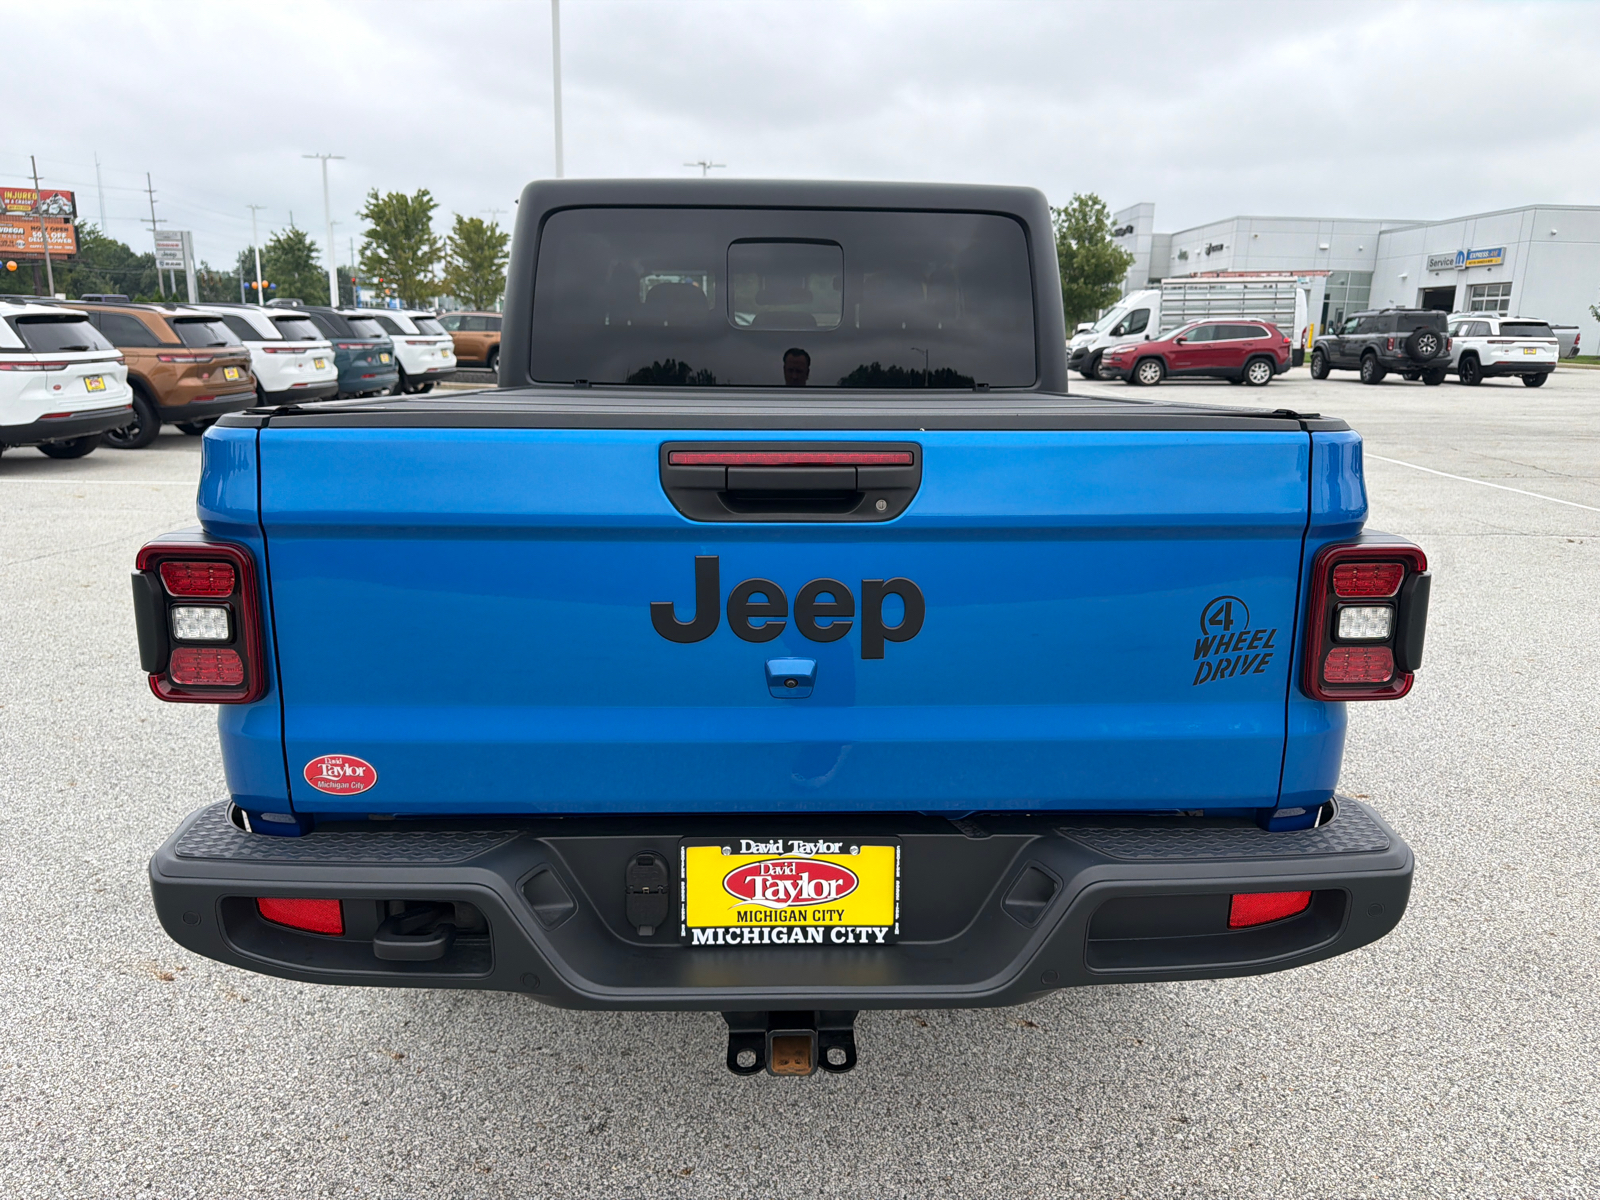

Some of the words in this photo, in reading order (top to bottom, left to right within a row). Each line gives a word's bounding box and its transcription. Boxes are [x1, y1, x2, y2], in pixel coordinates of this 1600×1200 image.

[4, 191, 37, 200] INJURED
[1429, 257, 1454, 267] Service
[650, 555, 926, 660] Jeep
[1208, 601, 1234, 631] 4
[1193, 628, 1278, 661] WHEEL
[1192, 652, 1275, 686] DRIVE
[324, 757, 343, 765] David
[317, 763, 366, 780] Taylor
[317, 780, 350, 790] Michigan
[350, 781, 365, 790] City
[740, 839, 784, 854] David
[788, 839, 843, 859] Taylor
[759, 863, 796, 876] David
[744, 872, 844, 909] Taylor
[736, 910, 808, 923] MICHIGAN
[812, 909, 845, 922] CITY
[691, 927, 825, 945] MICHIGAN
[830, 926, 889, 944] CITY
